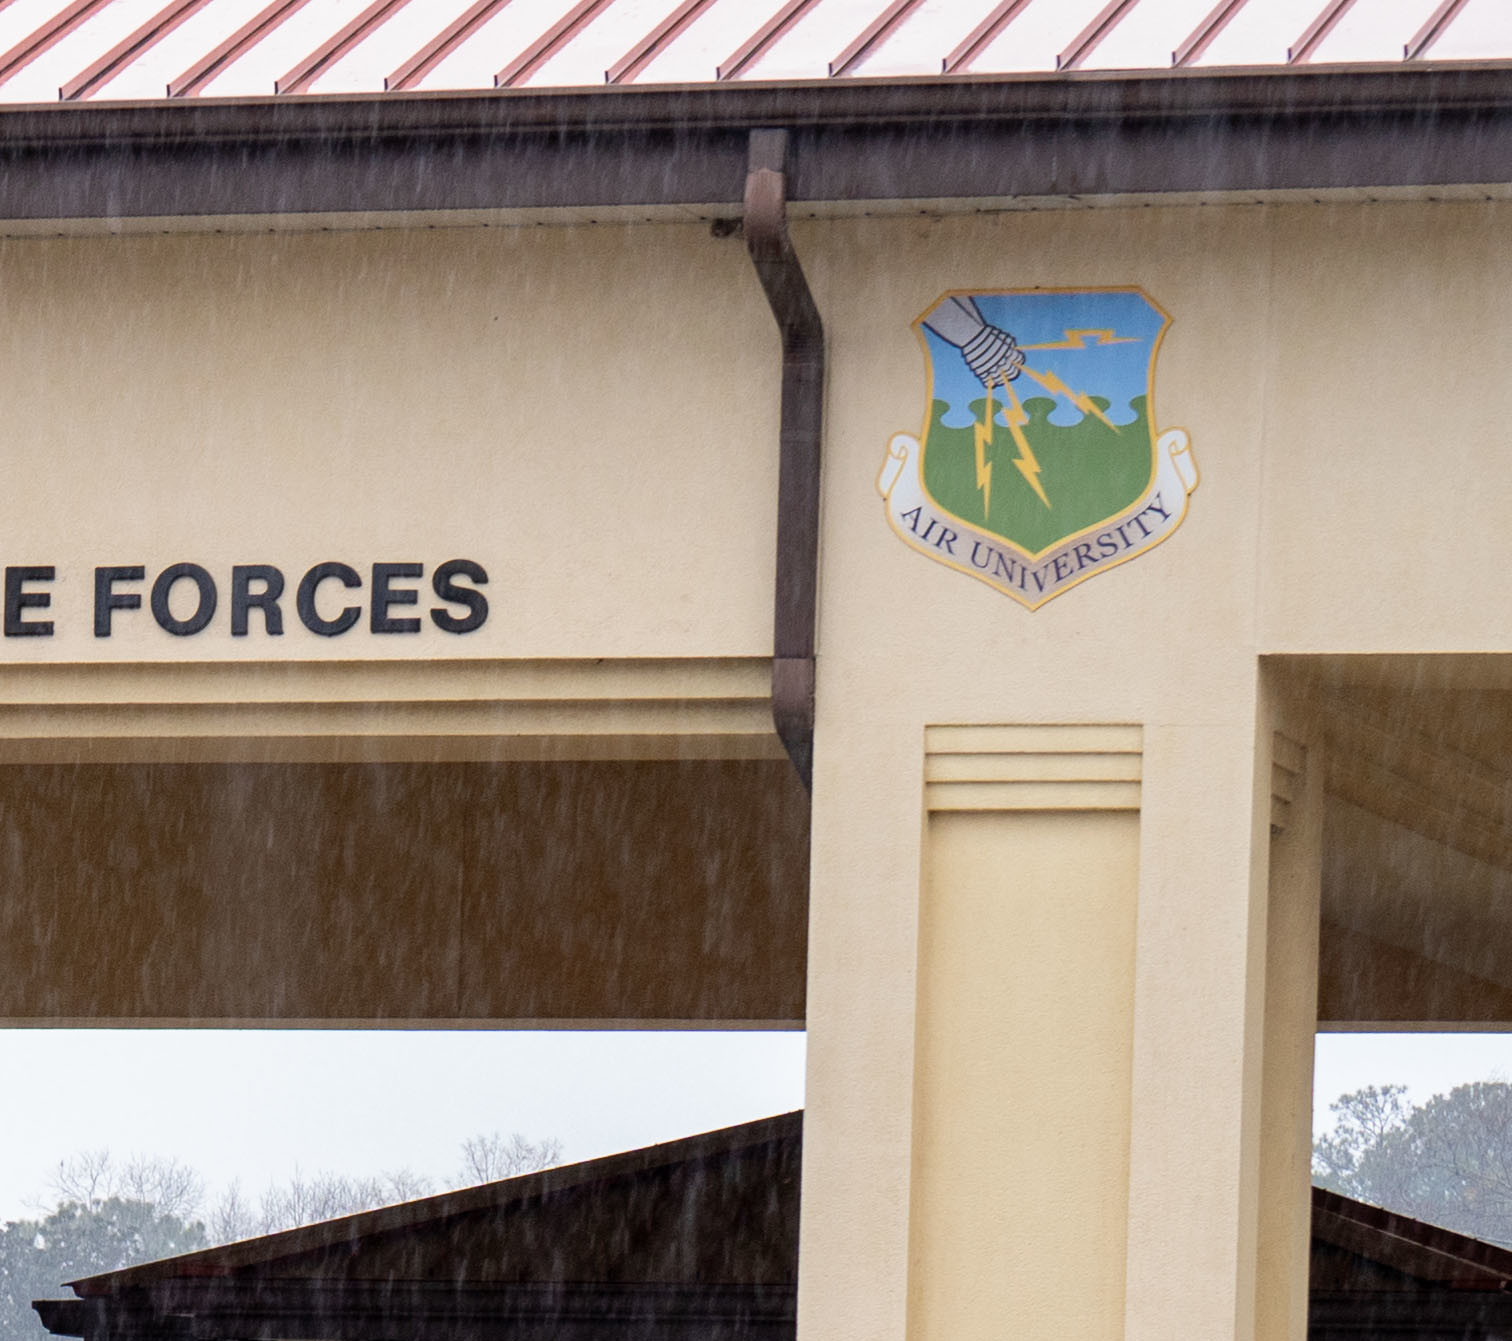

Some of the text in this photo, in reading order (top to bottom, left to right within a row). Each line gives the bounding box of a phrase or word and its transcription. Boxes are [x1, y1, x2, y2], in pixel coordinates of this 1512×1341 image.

[901, 492, 1172, 594] AIR UNIVERSITY
[93, 559, 490, 638] FORCES
